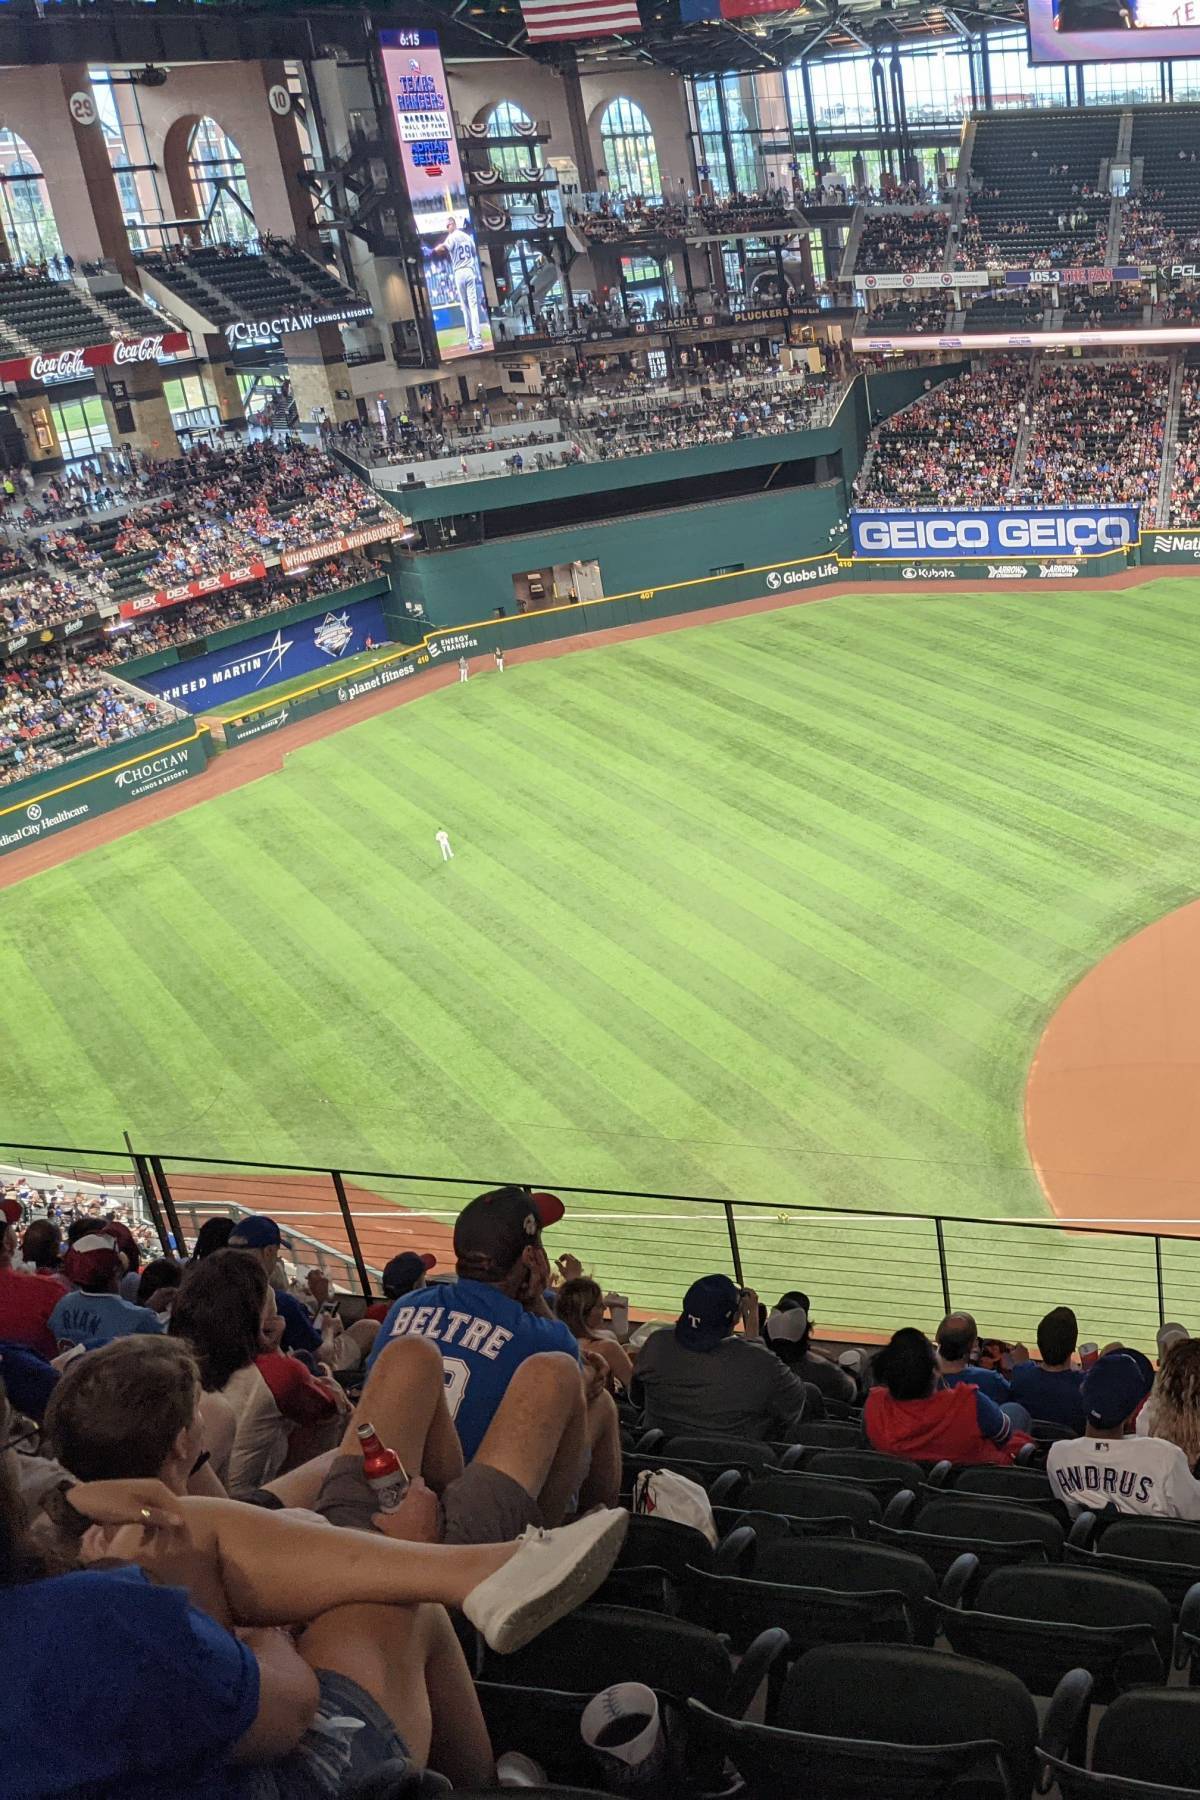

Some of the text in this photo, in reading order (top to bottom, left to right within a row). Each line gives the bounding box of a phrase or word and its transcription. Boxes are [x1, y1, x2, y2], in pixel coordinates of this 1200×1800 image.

[400, 33, 420, 46] 6:15
[399, 75, 435, 92] TEXAS
[273, 92, 287, 108] 10
[396, 93, 445, 111] RANGERS
[74, 100, 93, 118] 29
[411, 140, 449, 153] ADRIAN
[458, 245, 472, 260] 29
[1030, 267, 1113, 283] 105.3 THE FAN
[735, 307, 790, 322] PLUCKERS
[234, 308, 374, 340] CHOCTAW CASINOS & RESORTS
[346, 523, 401, 549] WHATABURGER
[858, 519, 989, 550] GEICO
[998, 516, 1130, 547] GEICO
[285, 541, 343, 568] WHATABURGER
[230, 567, 251, 580] DEX
[783, 564, 839, 585] Globe Life
[918, 568, 956, 578] Kubota
[998, 566, 1023, 574] ARROW
[1049, 565, 1074, 573] ARROW
[198, 576, 221, 589] DEX
[166, 585, 190, 599] DEX
[640, 591, 654, 600] 407
[133, 595, 157, 610] DEX
[440, 634, 469, 646] ENERGY
[441, 639, 478, 653] TRANSFER
[417, 654, 430, 665] 410
[213, 658, 262, 684] MARTIN
[348, 664, 415, 699] planet fitness
[122, 750, 189, 785] CHOCTAW
[131, 781, 158, 796] CASINOS
[163, 769, 189, 784] RESORTS
[22, 823, 41, 841] City
[42, 804, 89, 830] Healthcare
[63, 1310, 102, 1336] RYAN
[389, 1306, 514, 1360] BELTRE
[1056, 1466, 1154, 1503] ANDRUS
